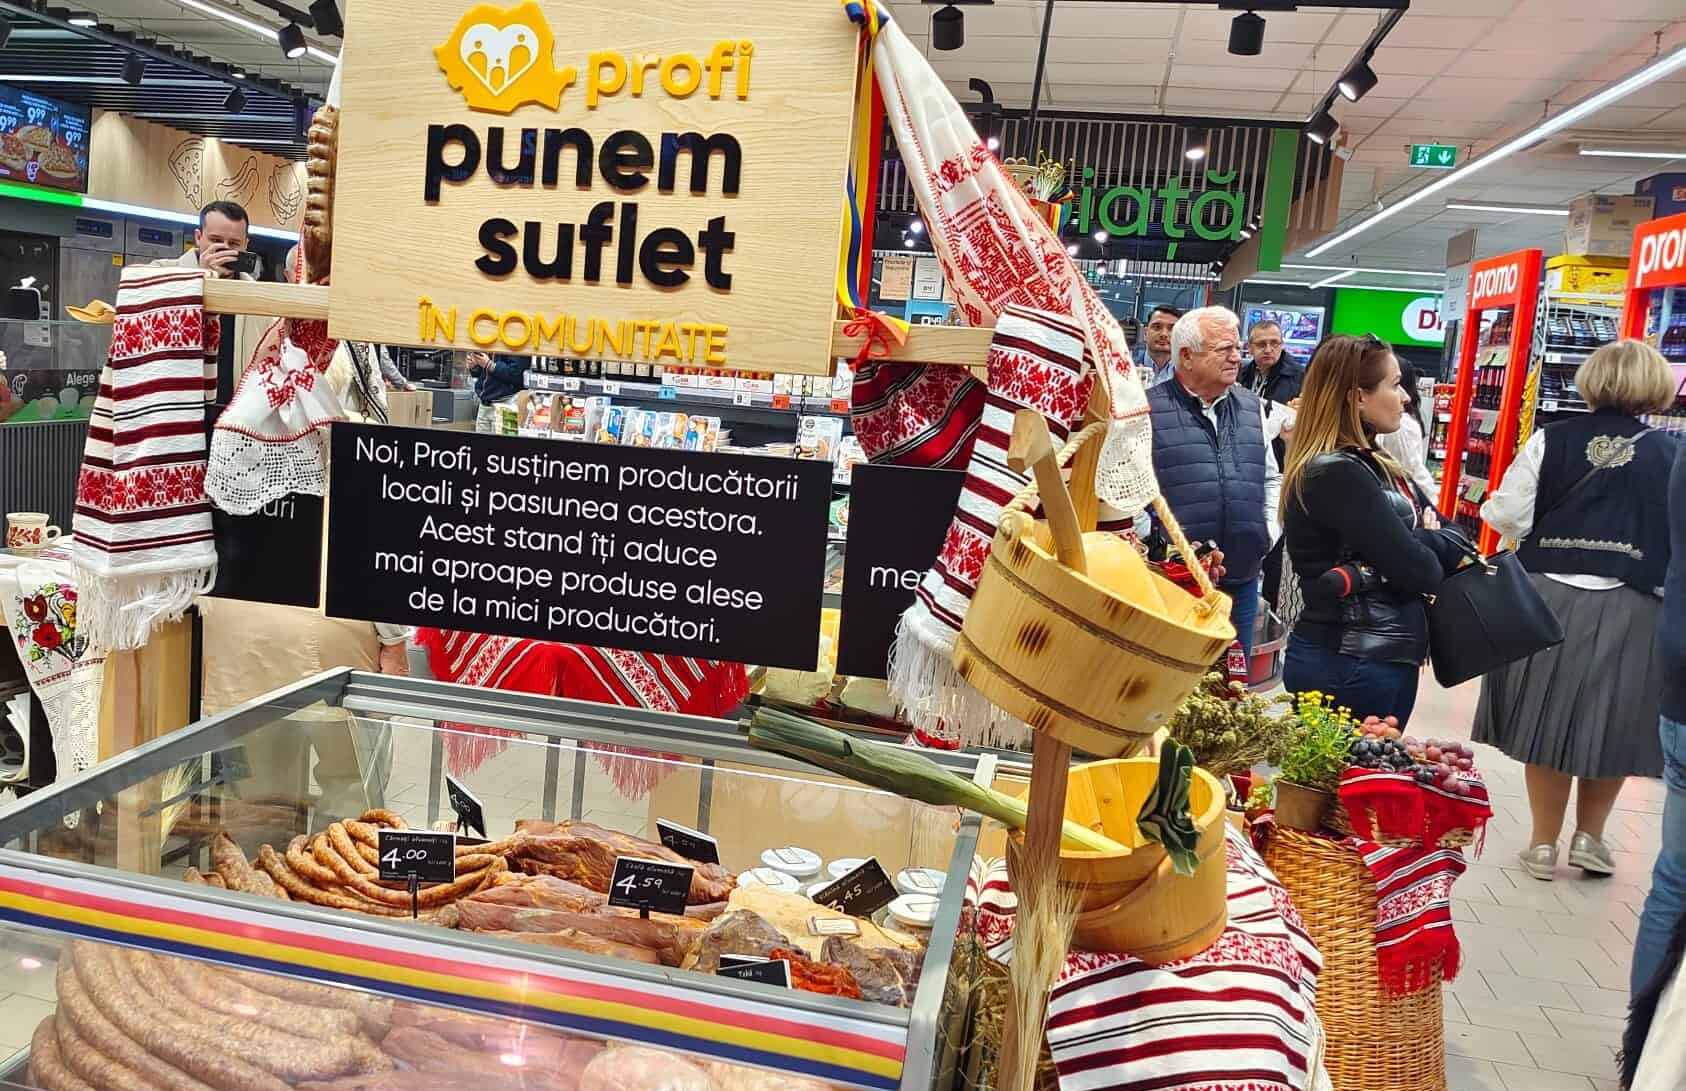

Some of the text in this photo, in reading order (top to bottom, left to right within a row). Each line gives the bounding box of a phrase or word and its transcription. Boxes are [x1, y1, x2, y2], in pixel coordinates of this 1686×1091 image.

[586, 40, 753, 109] profi
[424, 122, 743, 203] punem
[1064, 167, 1246, 260] iață
[474, 202, 736, 292] suflet
[1635, 228, 1686, 289] pro
[1471, 263, 1519, 310] promo
[418, 296, 729, 364] ÎN COMUNITATE
[66, 371, 96, 387] Alege
[356, 436, 799, 501] Noi, Profi, susținem producătorii
[382, 473, 763, 536] locali și pasiunea acestora.
[419, 514, 718, 568] Acest stand îți aduce
[375, 550, 764, 611] mai aproape produse alese
[408, 586, 721, 644] de la mici producători.
[381, 847, 428, 870] 4.00
[615, 874, 664, 896] 4.59
